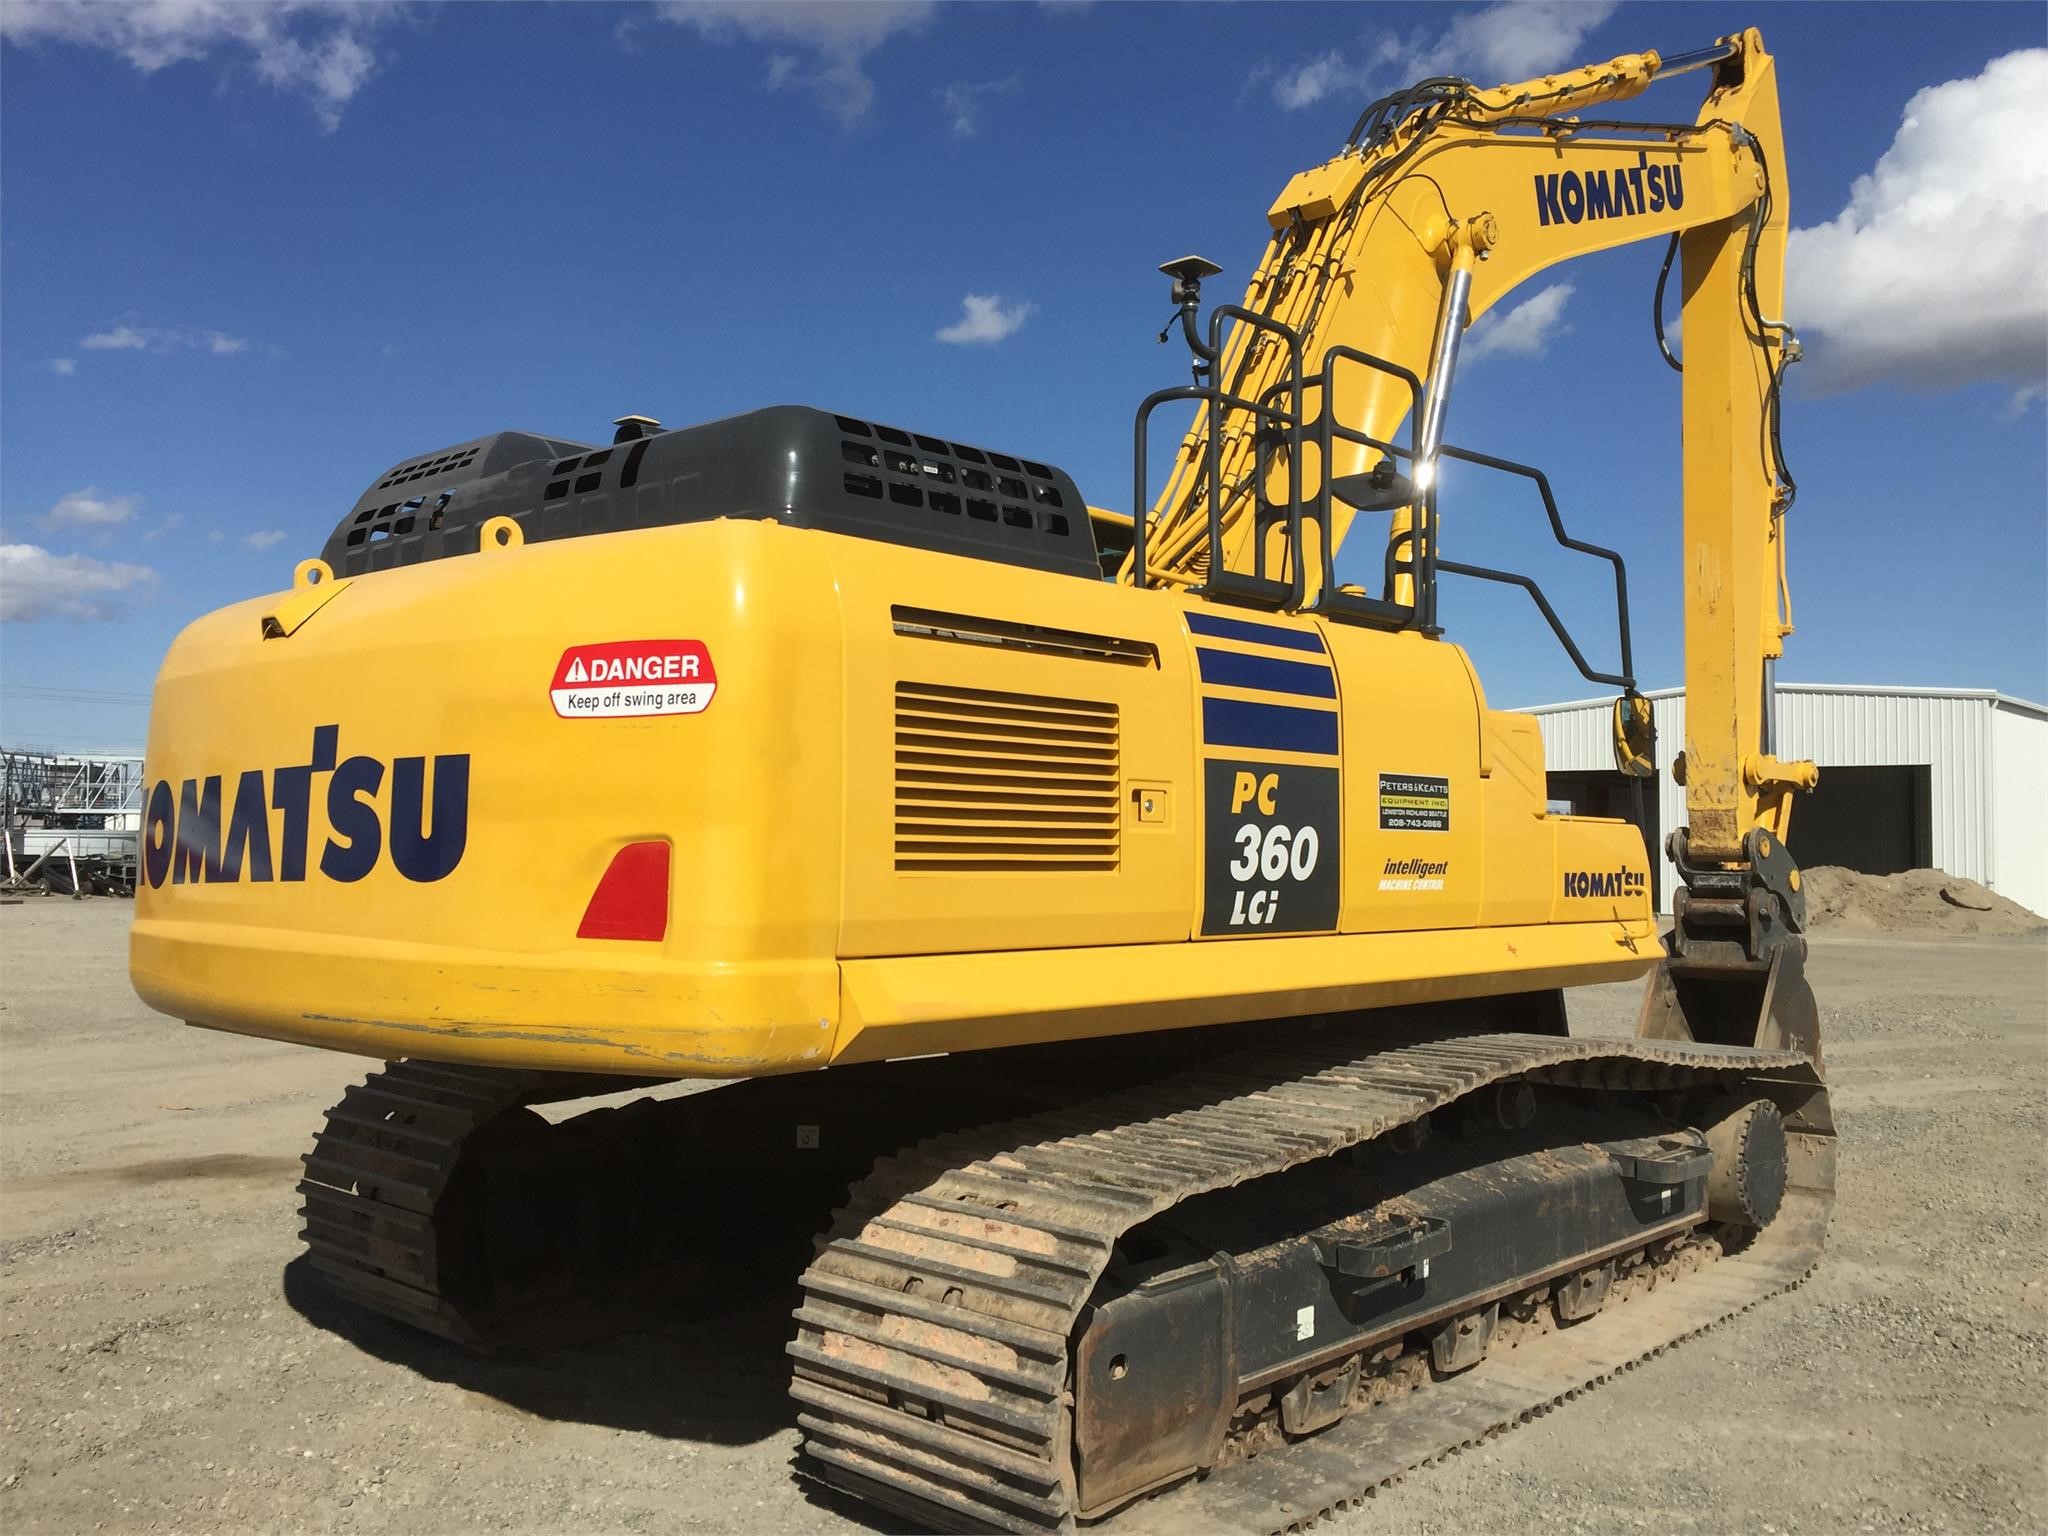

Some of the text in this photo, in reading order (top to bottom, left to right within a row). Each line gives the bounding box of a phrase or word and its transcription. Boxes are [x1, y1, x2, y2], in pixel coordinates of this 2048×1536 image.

[1534, 151, 1684, 227] KOMATSU
[590, 654, 700, 682] DANGER
[568, 691, 697, 711] Keep off swing area
[1231, 771, 1280, 816] PC
[1382, 797, 1429, 806] EQUIPMENT
[1230, 823, 1319, 882] 360
[1384, 858, 1448, 879] intelligent
[1229, 890, 1280, 925] LCi
